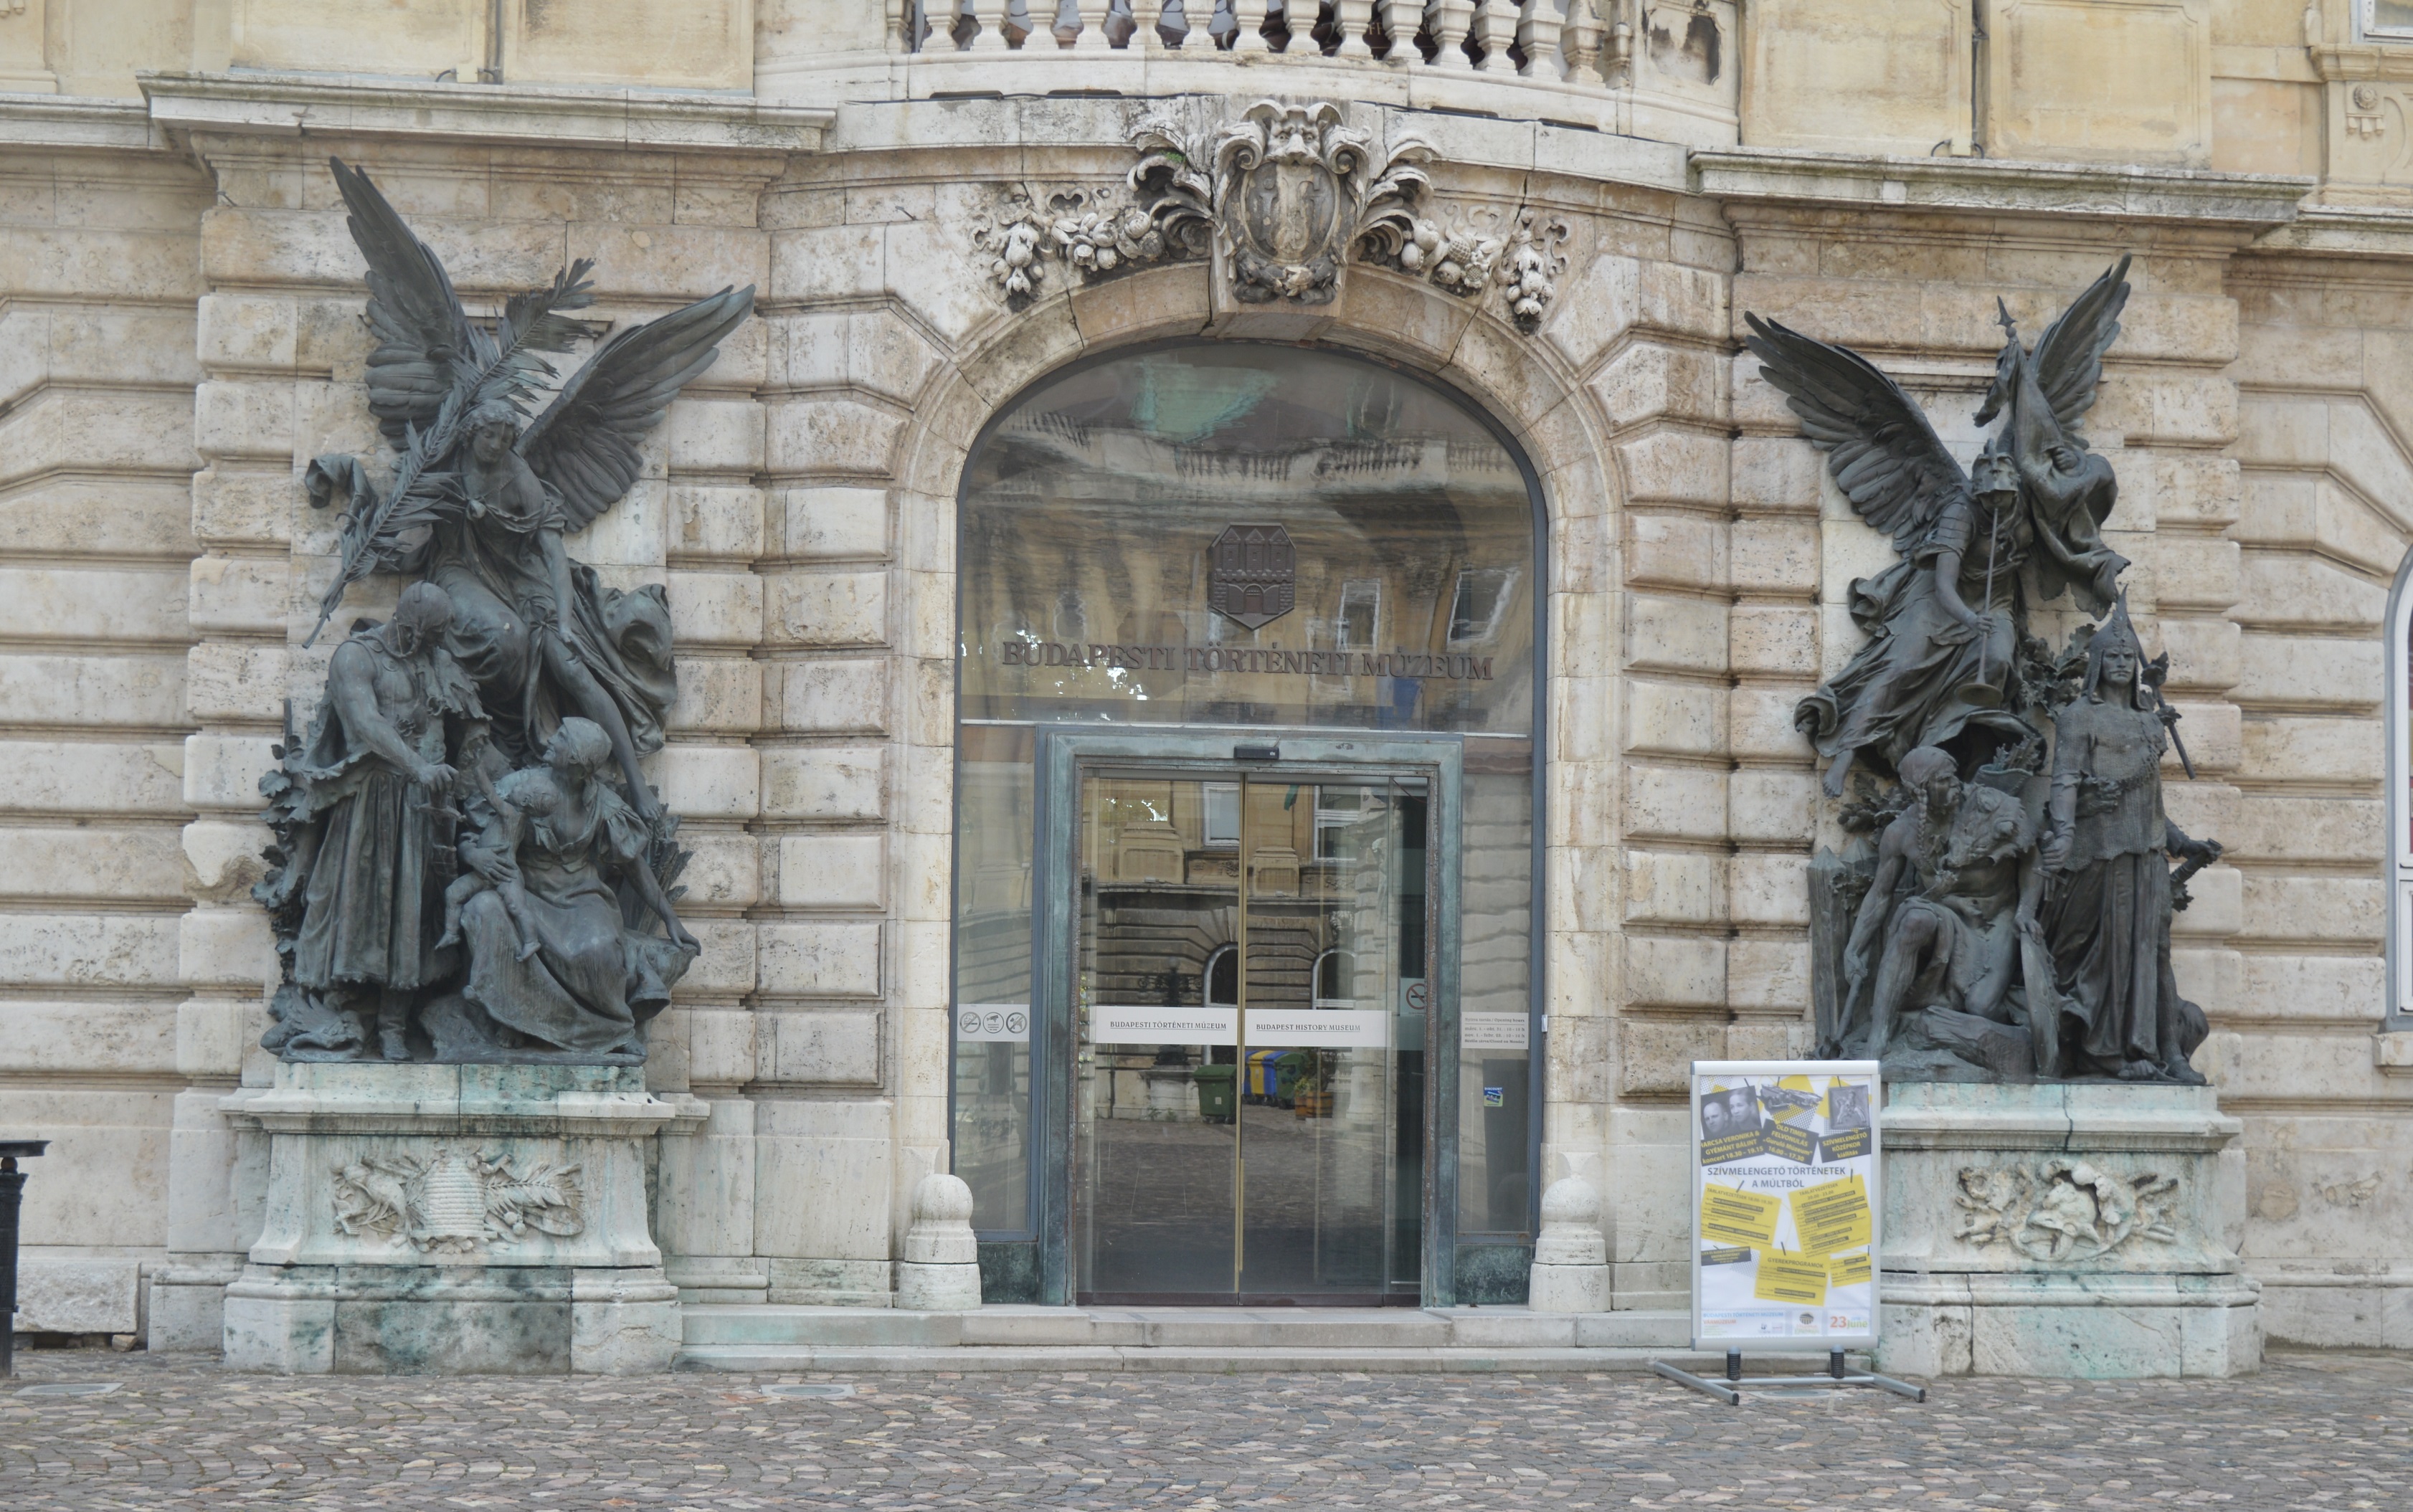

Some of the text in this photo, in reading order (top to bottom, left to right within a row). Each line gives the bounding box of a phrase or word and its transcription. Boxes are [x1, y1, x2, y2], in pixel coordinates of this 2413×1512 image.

[1002, 641, 1494, 680] BUDAPESTI TÖRTÉNETI MÚZEUM
[1152, 1020, 1193, 1029] TÖRTÉNETI
[1195, 1021, 1227, 1030] MÚZEUM
[1776, 1123, 1807, 1138] OLD TIMER
[1723, 1131, 1754, 1143] VERONIKA
[1771, 1130, 1808, 1147] FELVONULÁS
[1702, 1154, 1726, 1164] koncert
[1707, 1165, 1846, 1176] SZÍVMELENGETŐ TÖRTÉNETEK
[1752, 1178, 1805, 1188] A MÚLTBÓL
[1767, 1257, 1824, 1268] GYEREKPROGRAMOK
[1830, 1316, 1847, 1328] 23
